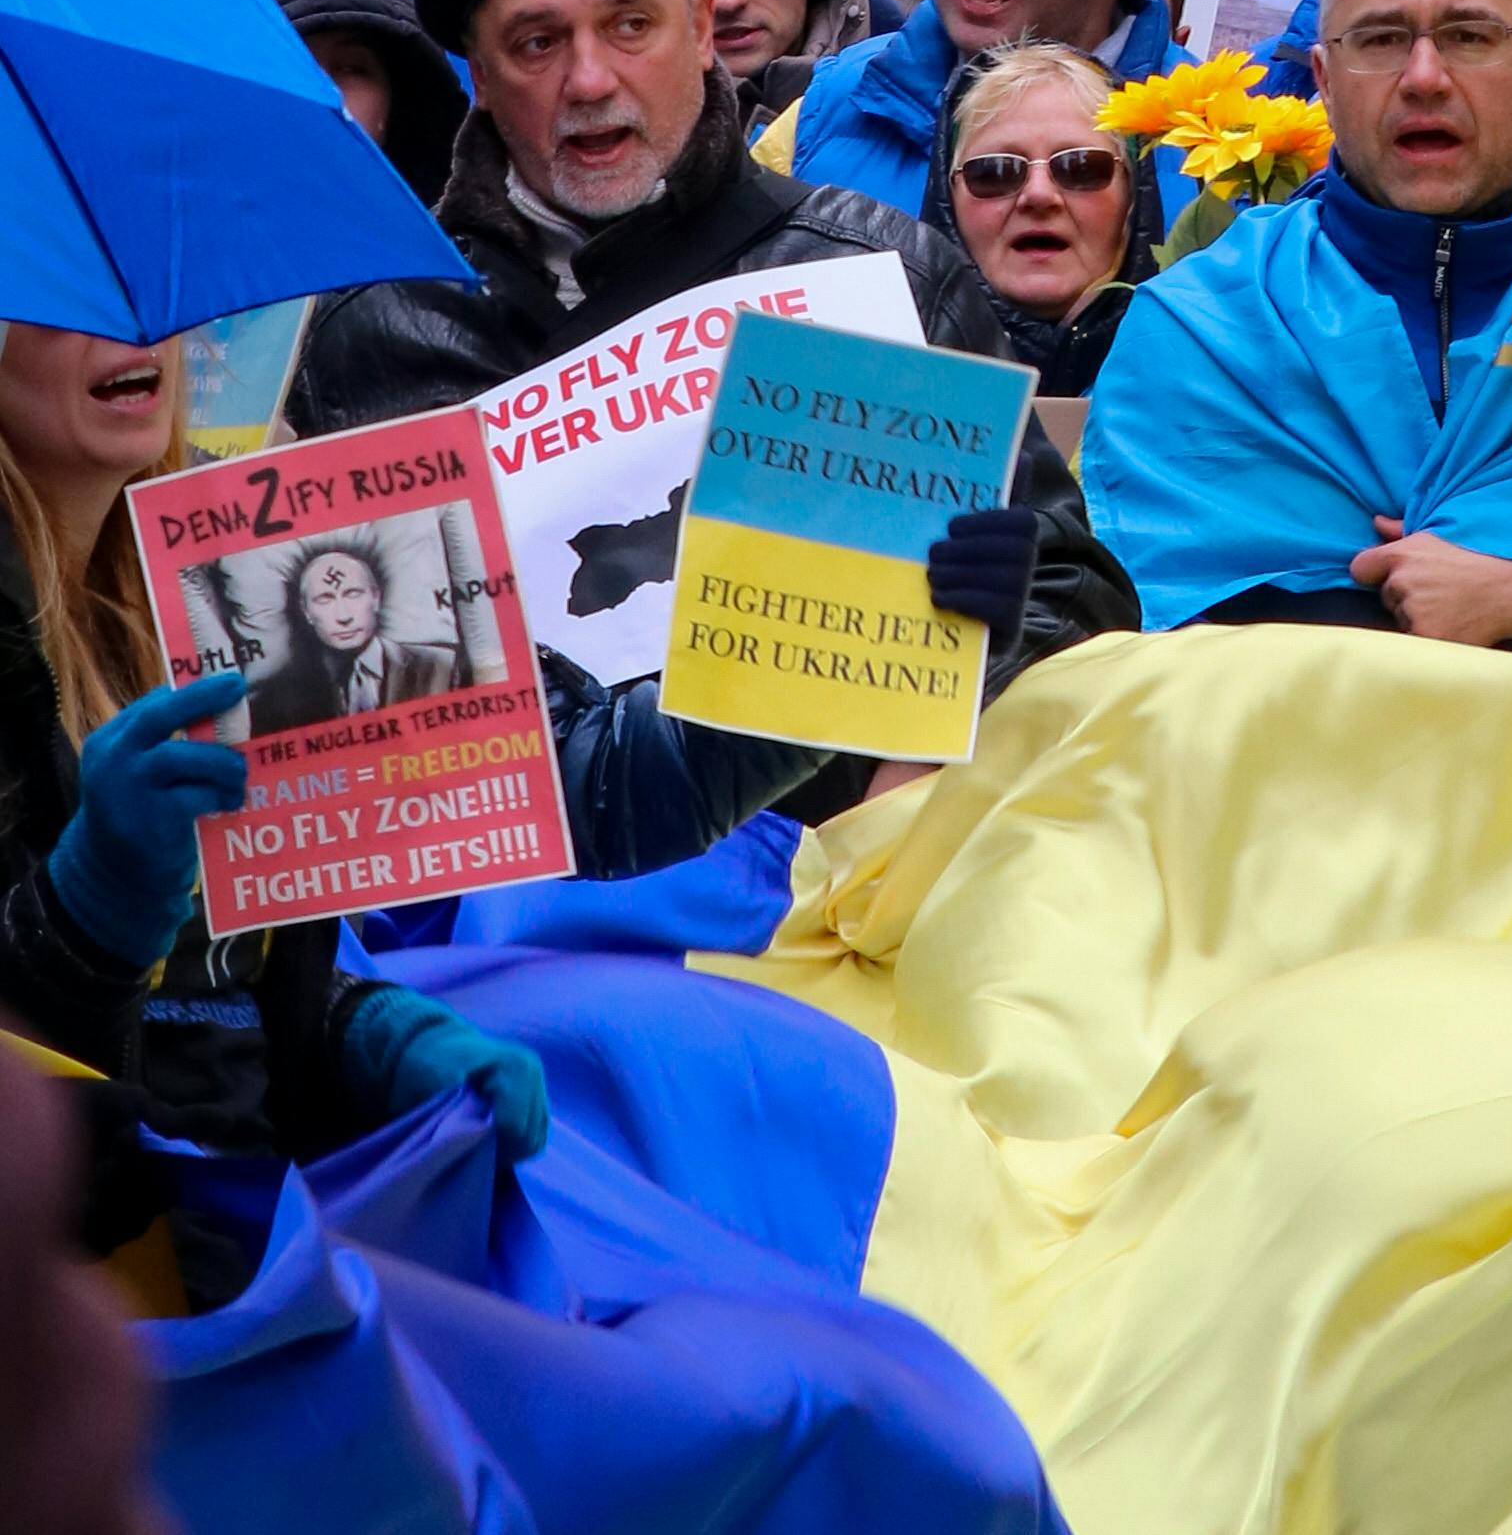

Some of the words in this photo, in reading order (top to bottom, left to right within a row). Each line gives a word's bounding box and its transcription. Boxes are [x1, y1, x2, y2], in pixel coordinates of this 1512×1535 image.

[483, 383, 550, 432] NO
[558, 331, 645, 403] FLY
[741, 375, 800, 414] NO
[809, 389, 875, 430] FLY
[885, 406, 994, 459] ZONE
[347, 449, 468, 502] RUSSIA
[707, 425, 809, 475] OVER
[820, 447, 1002, 514] UKRAINE!
[697, 573, 866, 638] FIGHTER
[869, 612, 962, 653] JETS
[685, 619, 760, 667] FOR
[771, 640, 961, 701] UKRAINE!
[257, 736, 299, 766] THE
[305, 717, 403, 756] NUCLEAR
[409, 686, 541, 733] TERRORIST!
[206, 767, 351, 819] RAINE
[380, 729, 543, 786] FREEDOM
[224, 819, 285, 864] NO
[292, 805, 361, 851] FLY
[373, 772, 531, 834] ZONE!!!!
[232, 853, 397, 911] FIGHTER
[407, 823, 541, 885] JETS!!!!
